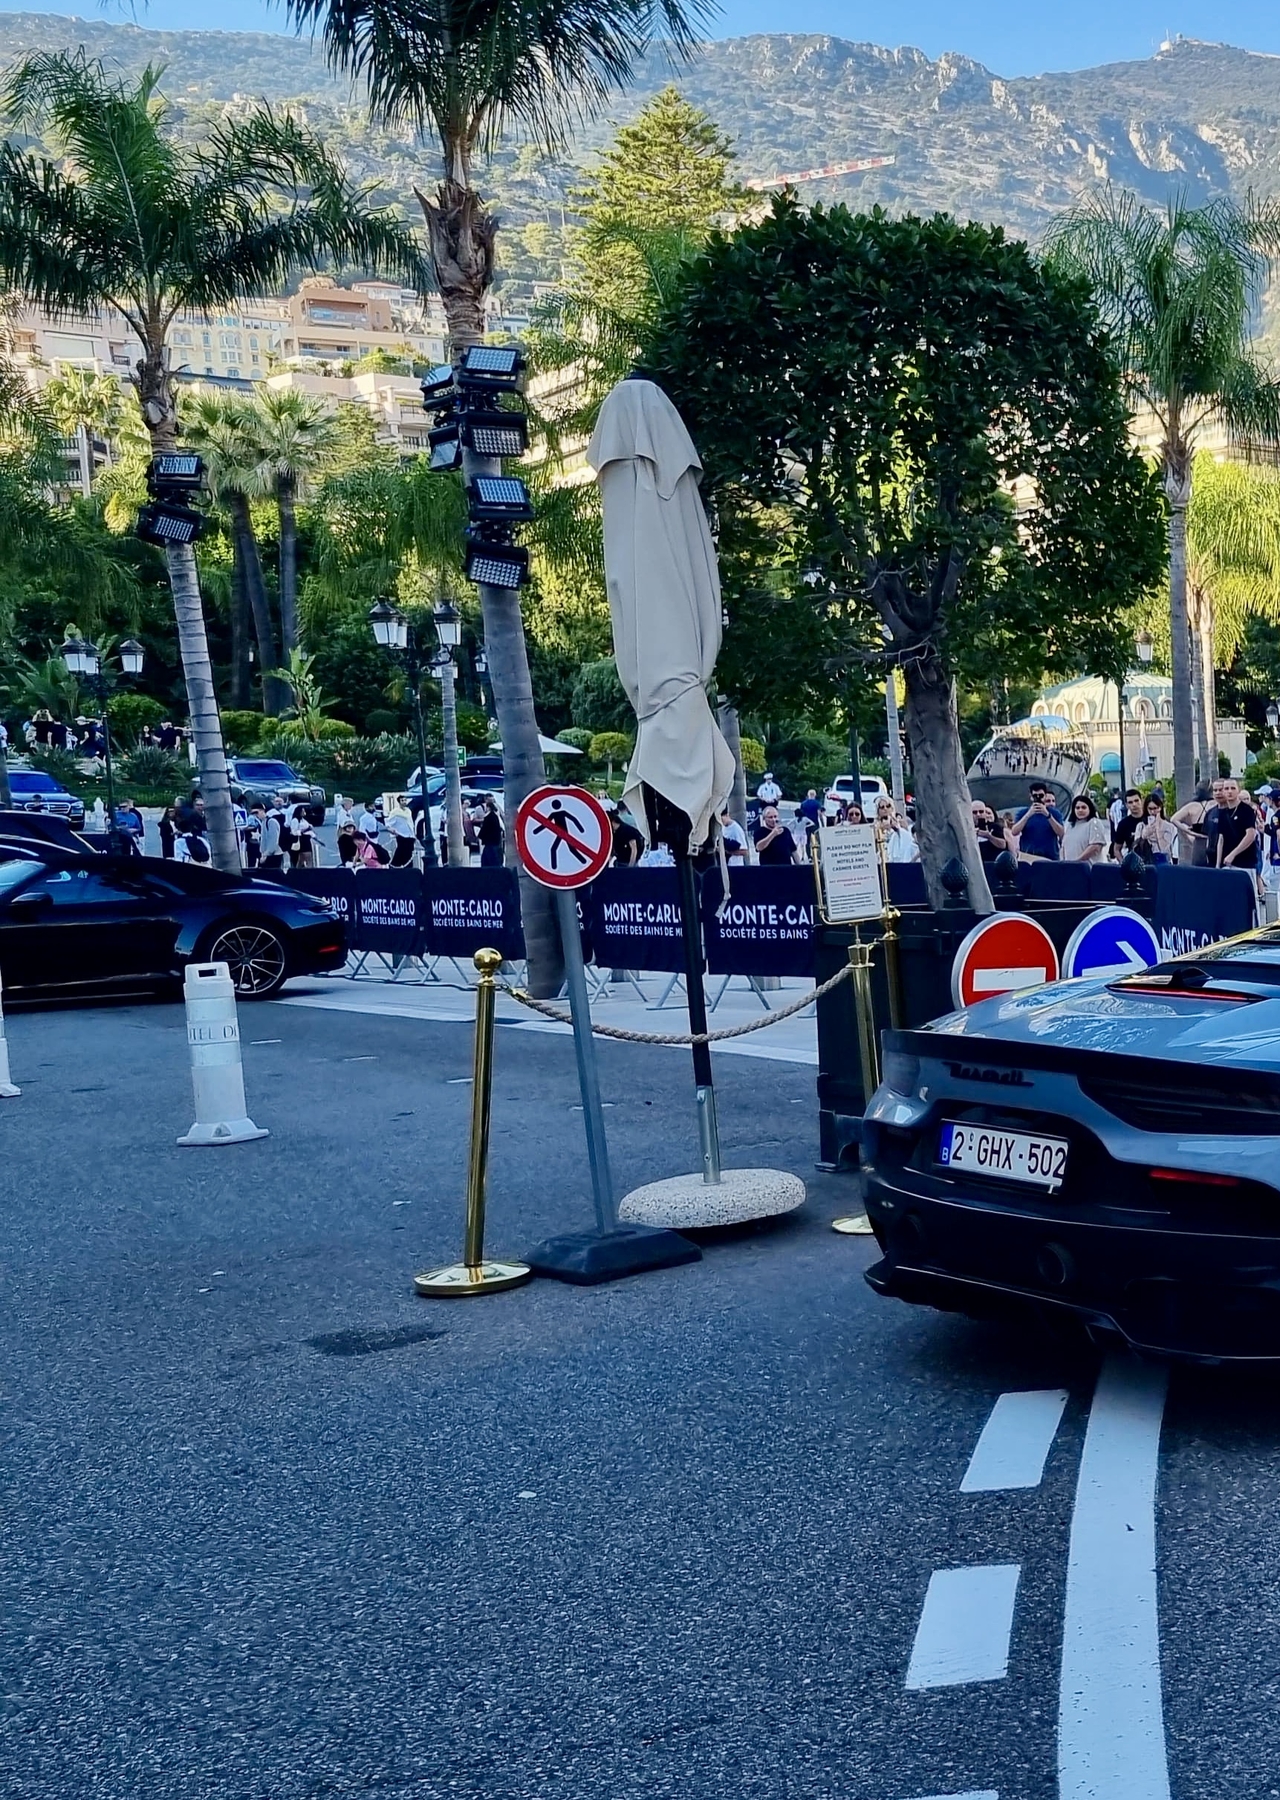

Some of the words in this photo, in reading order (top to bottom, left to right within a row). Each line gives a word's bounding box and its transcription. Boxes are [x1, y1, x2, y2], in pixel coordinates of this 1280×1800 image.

[603, 902, 682, 924] MONTE·CARL
[454, 918, 466, 928] DES
[630, 926, 643, 935] DES
[664, 927, 674, 937] DE
[720, 926, 757, 939] SOCIÉTÉ
[759, 928, 778, 939] DES
[780, 928, 809, 939] BAINS
[941, 1147, 949, 1161] B
